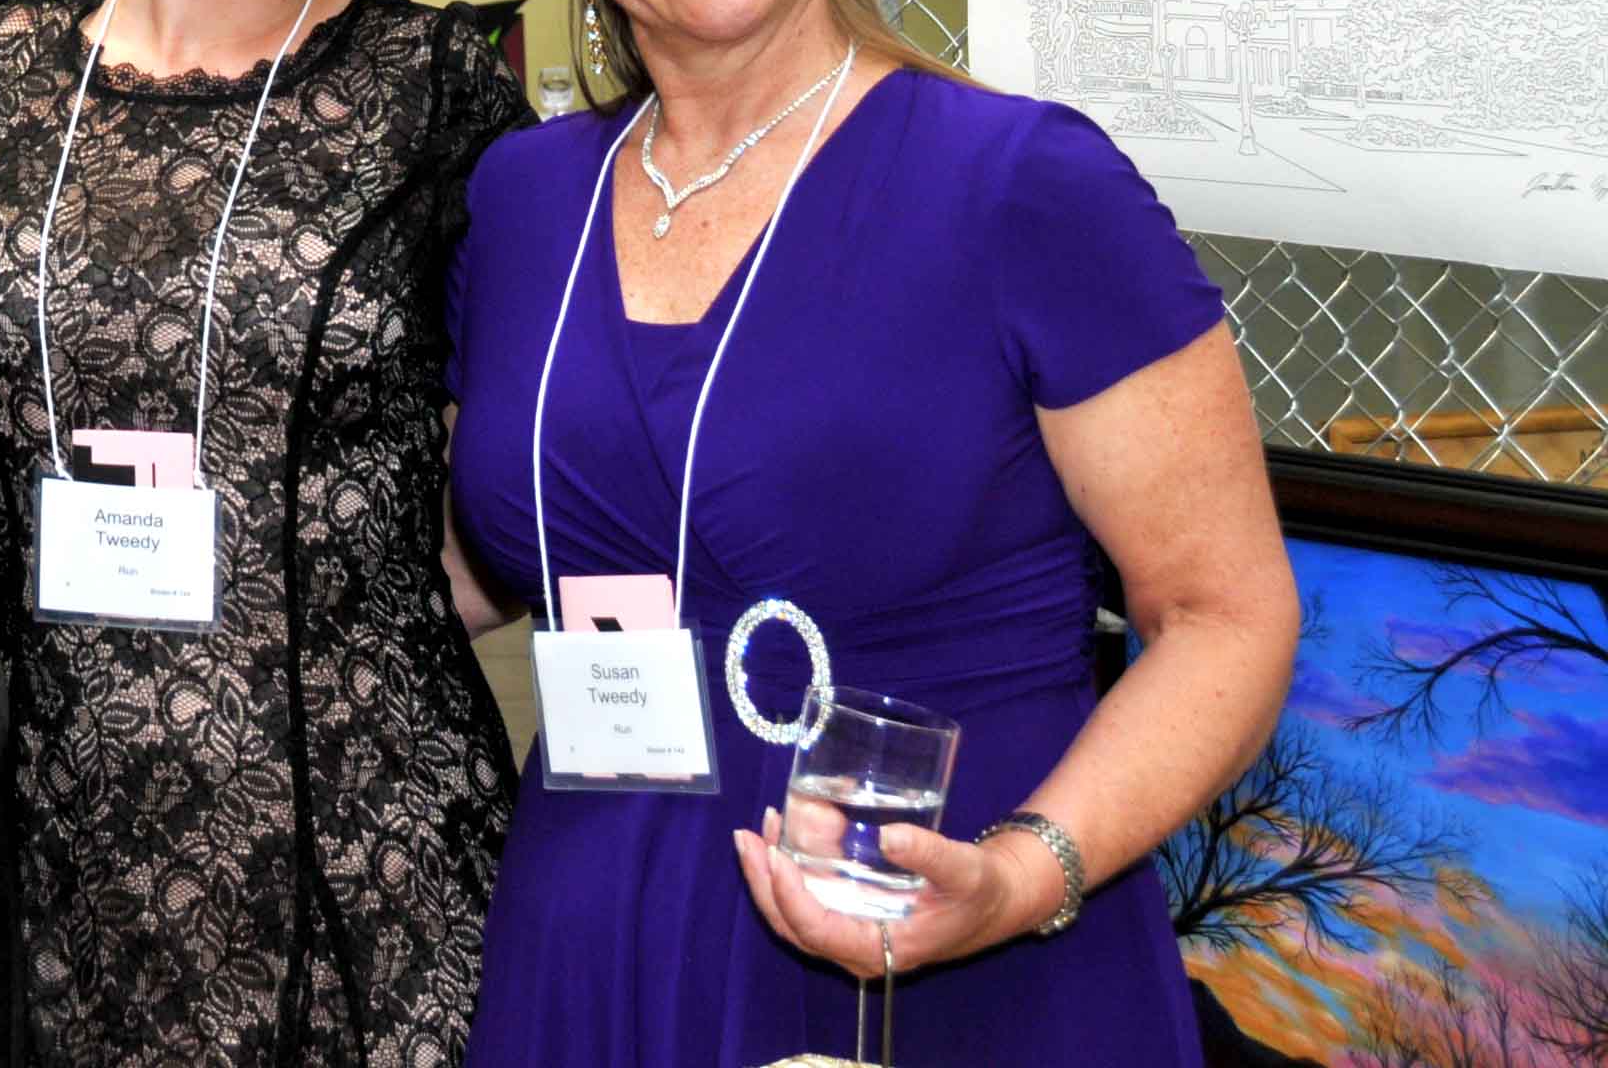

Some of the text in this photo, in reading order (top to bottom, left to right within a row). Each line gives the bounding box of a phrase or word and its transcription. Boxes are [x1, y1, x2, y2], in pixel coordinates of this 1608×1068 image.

[94, 508, 163, 528] Amanda
[95, 531, 160, 553] Tweedy
[591, 663, 640, 680] Susan
[587, 687, 648, 708] Tweedy
